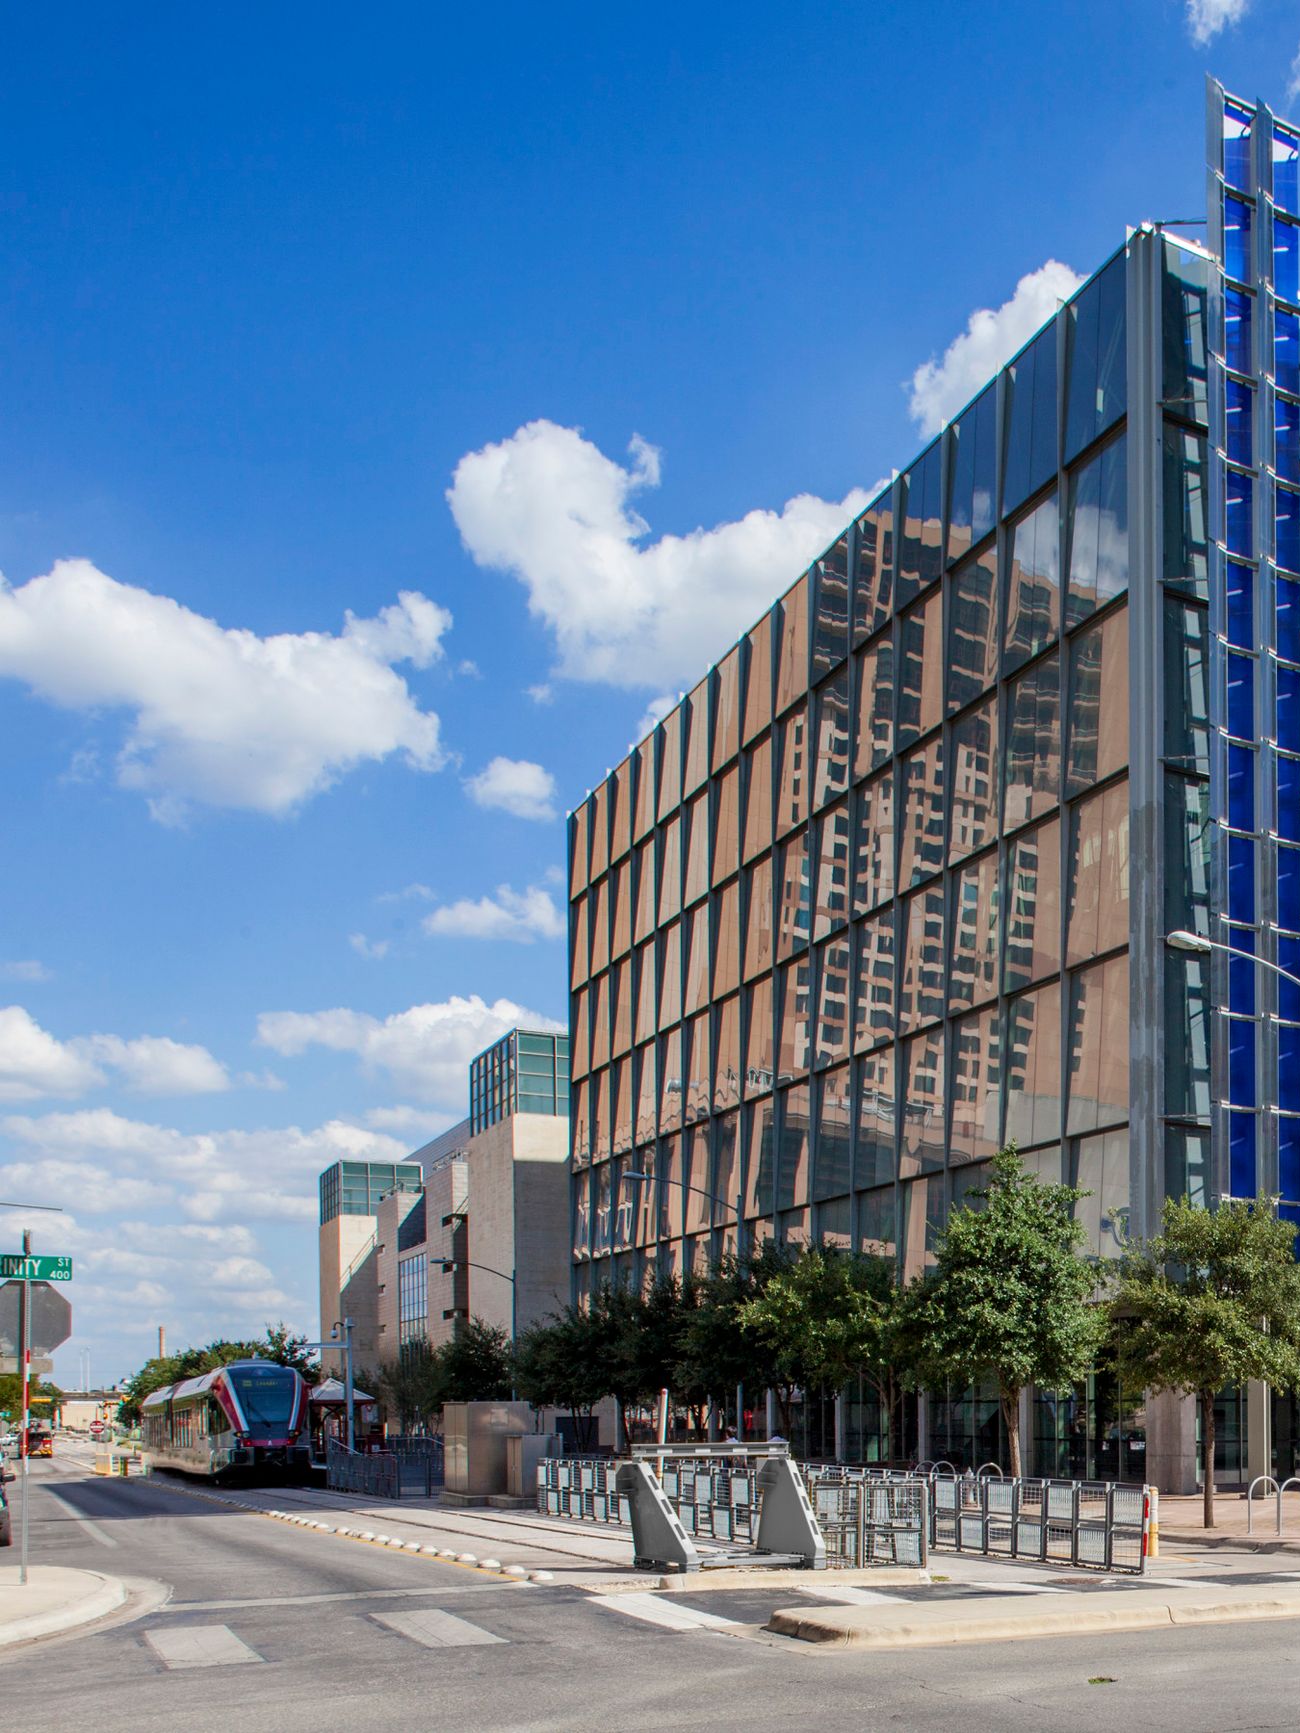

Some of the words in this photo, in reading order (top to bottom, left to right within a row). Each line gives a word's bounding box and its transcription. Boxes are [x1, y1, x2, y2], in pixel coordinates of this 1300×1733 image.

[0, 1258, 42, 1276] INITY
[58, 1258, 70, 1267] ST
[50, 1270, 70, 1280] 400
